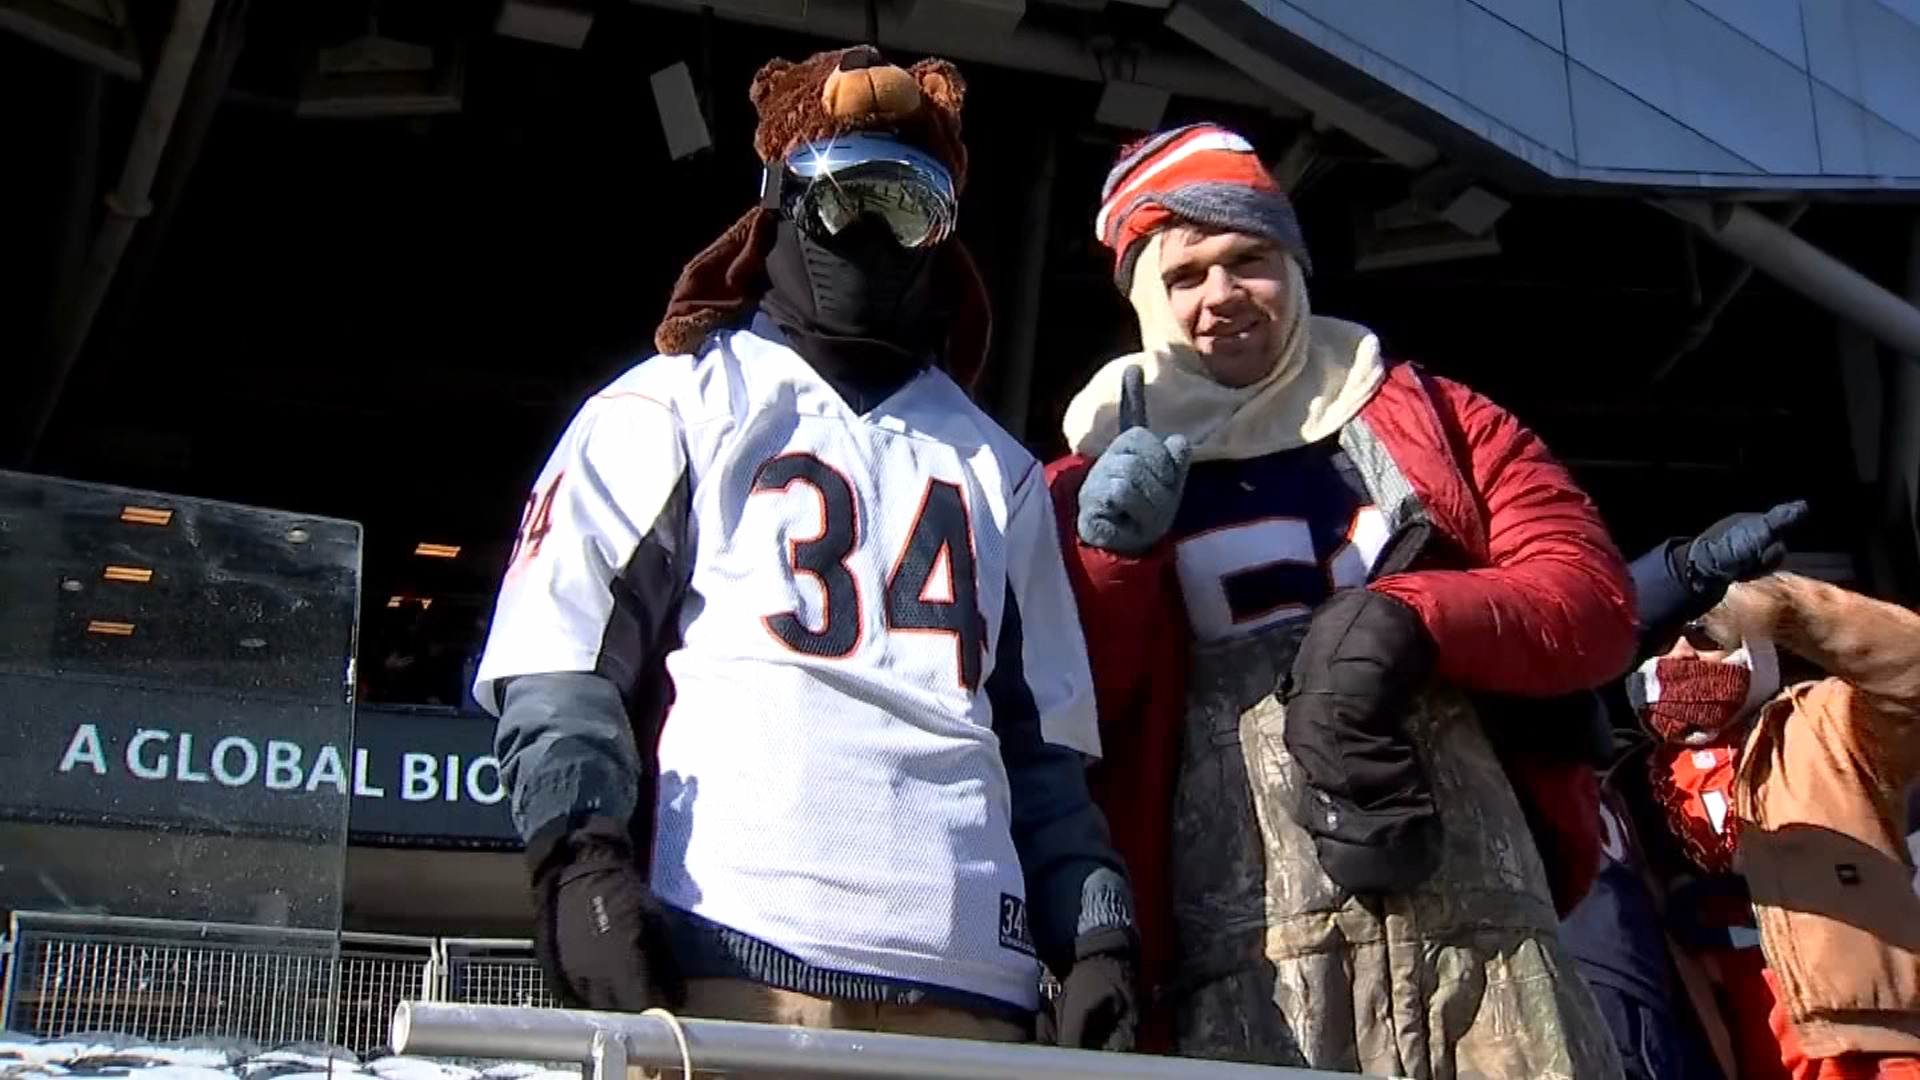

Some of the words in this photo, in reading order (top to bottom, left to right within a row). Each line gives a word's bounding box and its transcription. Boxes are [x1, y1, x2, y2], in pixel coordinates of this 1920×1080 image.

[752, 451, 985, 690] 34
[60, 724, 106, 774] A
[126, 729, 385, 798] GLOBAL
[1001, 897, 1024, 941] 34
